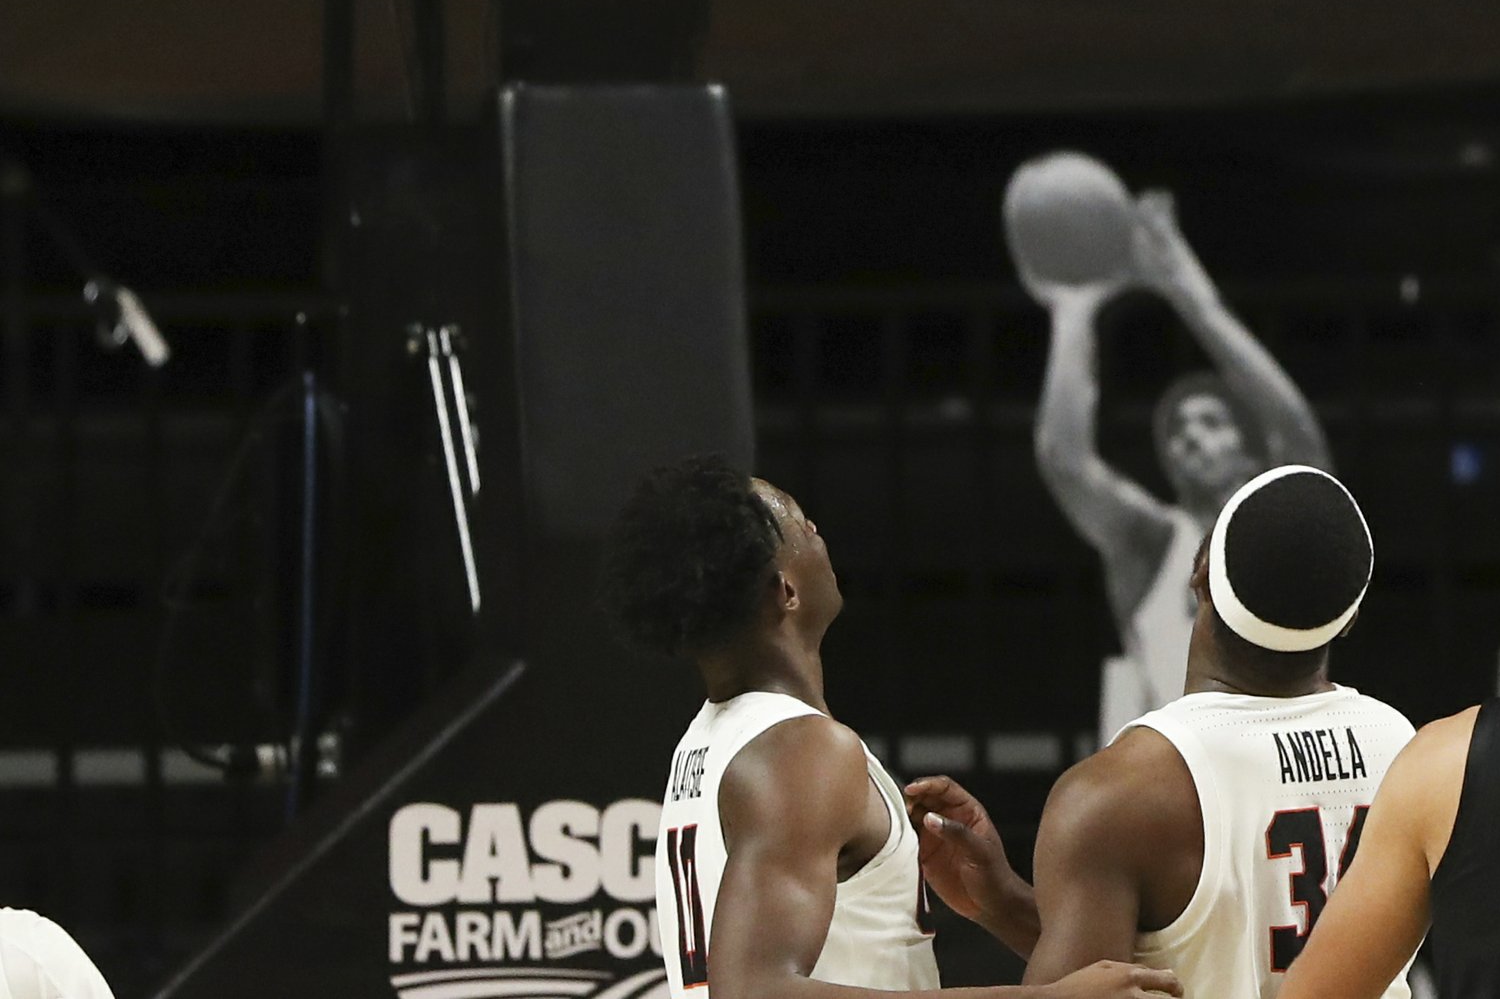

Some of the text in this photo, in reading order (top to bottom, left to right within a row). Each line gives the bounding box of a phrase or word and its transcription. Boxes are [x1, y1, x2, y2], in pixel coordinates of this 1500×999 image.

[1272, 726, 1367, 784] ANDELA
[1265, 805, 1371, 973] 3
[389, 910, 543, 963] FARM
[547, 908, 601, 953] and
